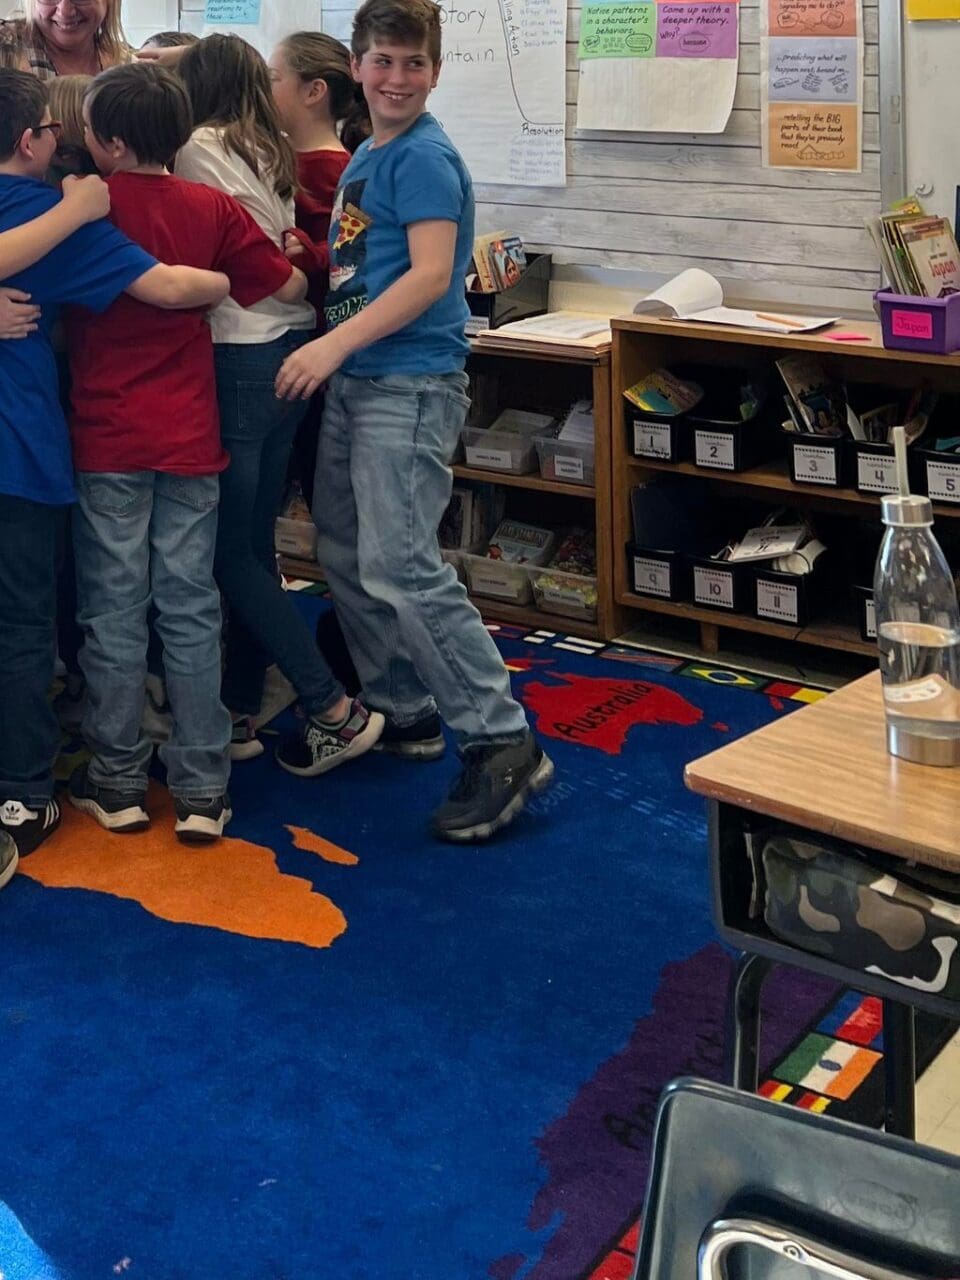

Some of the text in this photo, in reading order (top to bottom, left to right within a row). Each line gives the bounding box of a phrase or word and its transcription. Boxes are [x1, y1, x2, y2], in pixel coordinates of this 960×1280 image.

[436, 0, 487, 33] Story
[613, 7, 648, 16] patterns
[662, 6, 684, 14] Come
[687, 7, 698, 16] up
[701, 5, 722, 14] with
[602, 15, 649, 25] character's
[662, 16, 693, 26] deeper
[826, 113, 841, 124] BIG
[928, 260, 957, 280] Japan
[896, 317, 929, 335] Japan
[710, 446, 718, 458] 2
[809, 460, 818, 472] 3
[875, 471, 885, 483] 4
[946, 478, 956, 492] 5
[709, 582, 721, 596] 10
[553, 684, 651, 738] Australia
